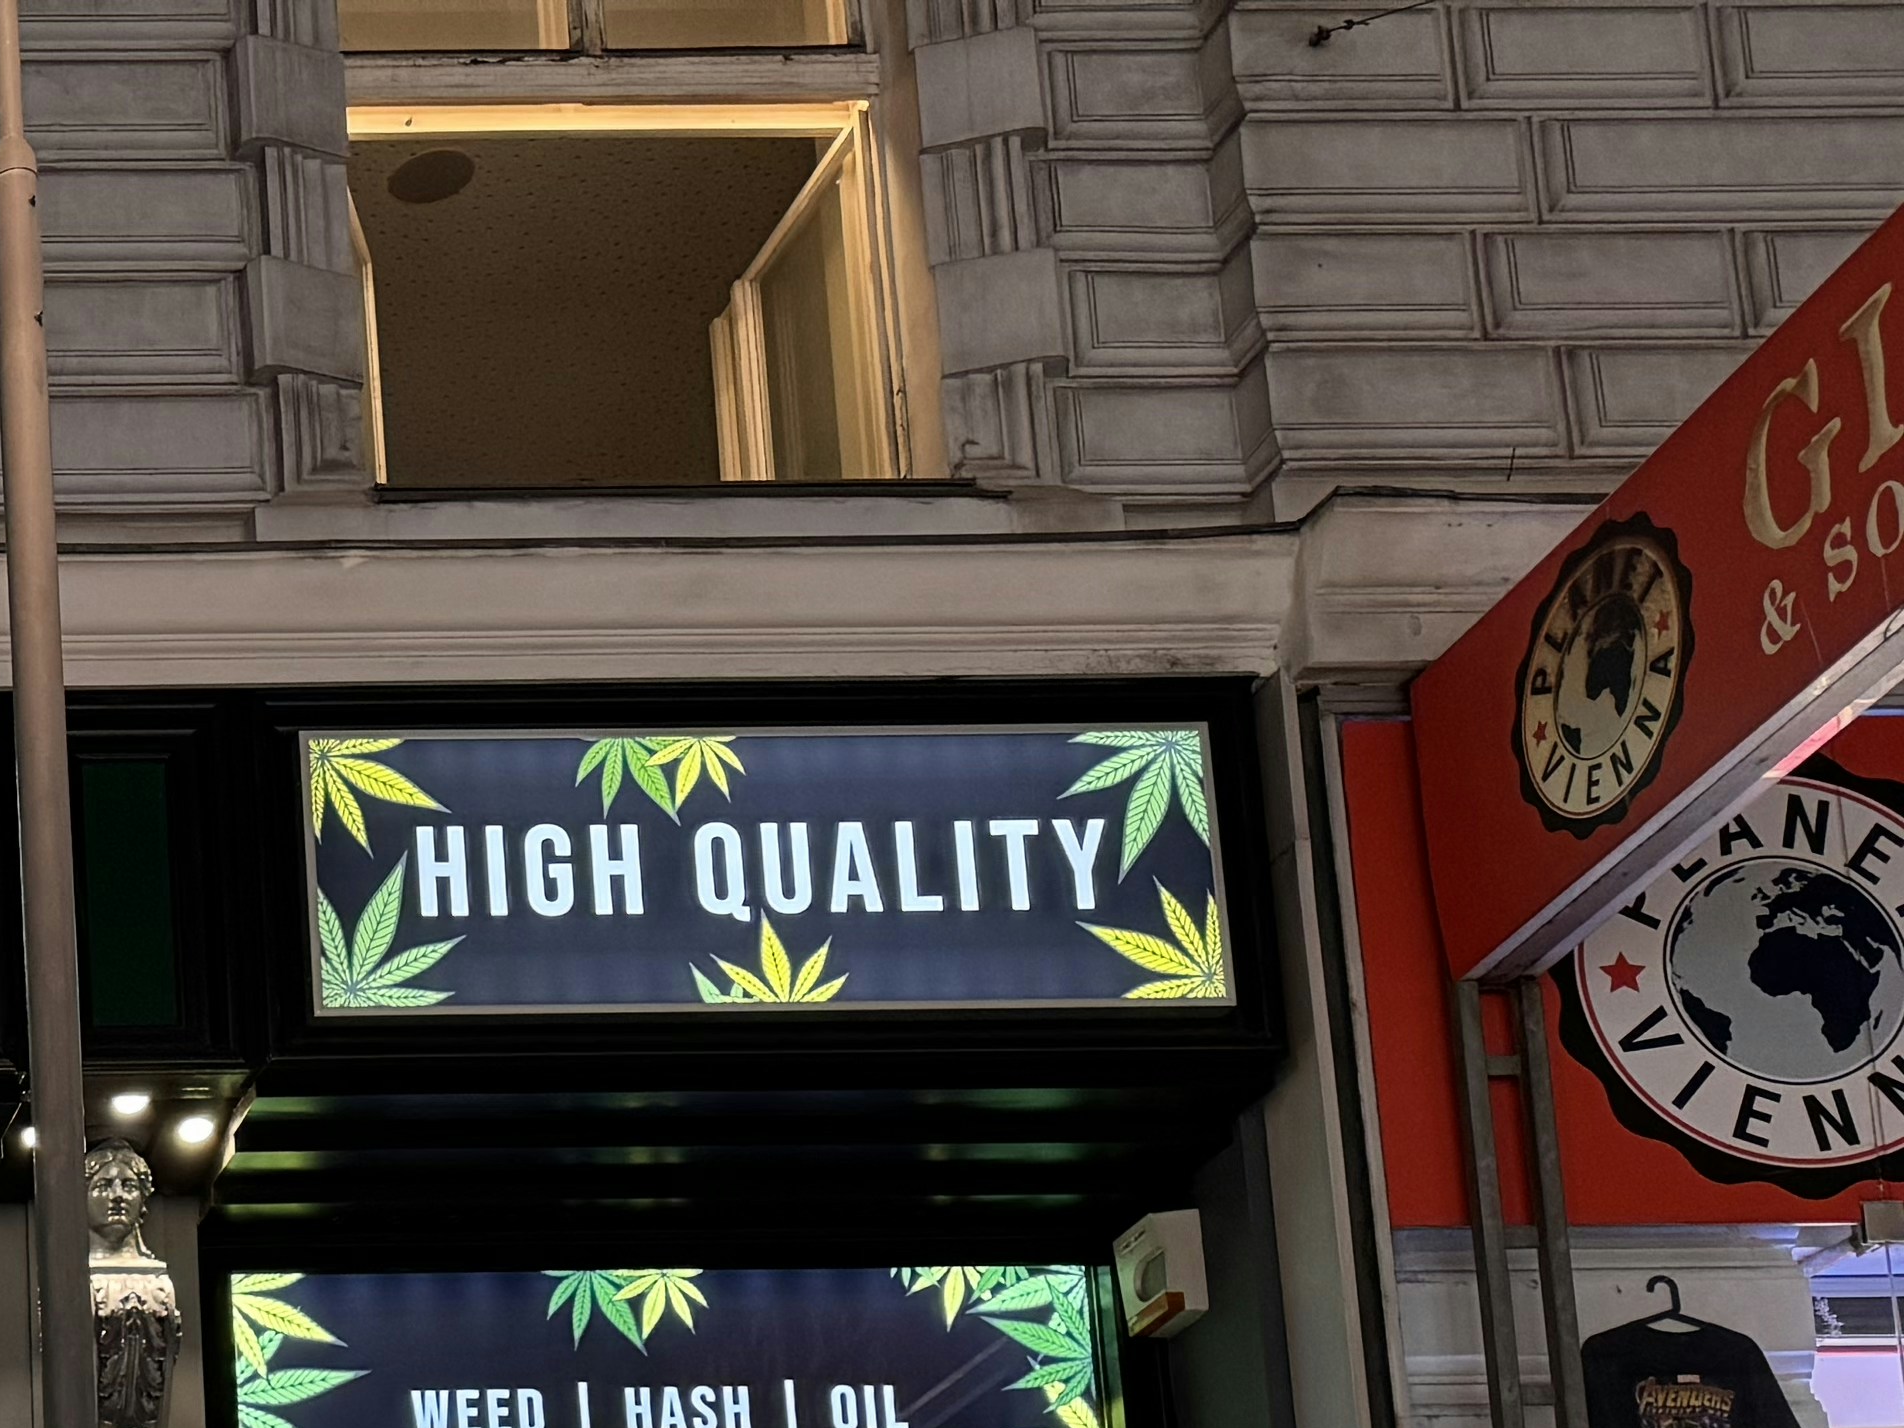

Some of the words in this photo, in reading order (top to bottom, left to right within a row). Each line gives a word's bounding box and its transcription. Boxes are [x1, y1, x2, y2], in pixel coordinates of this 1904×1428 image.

[1529, 547, 1665, 698] PLANET
[1758, 579, 1801, 655] &
[1539, 648, 1677, 808] VIENNA
[416, 823, 644, 917] HIGH
[695, 818, 1105, 922] QUALITY
